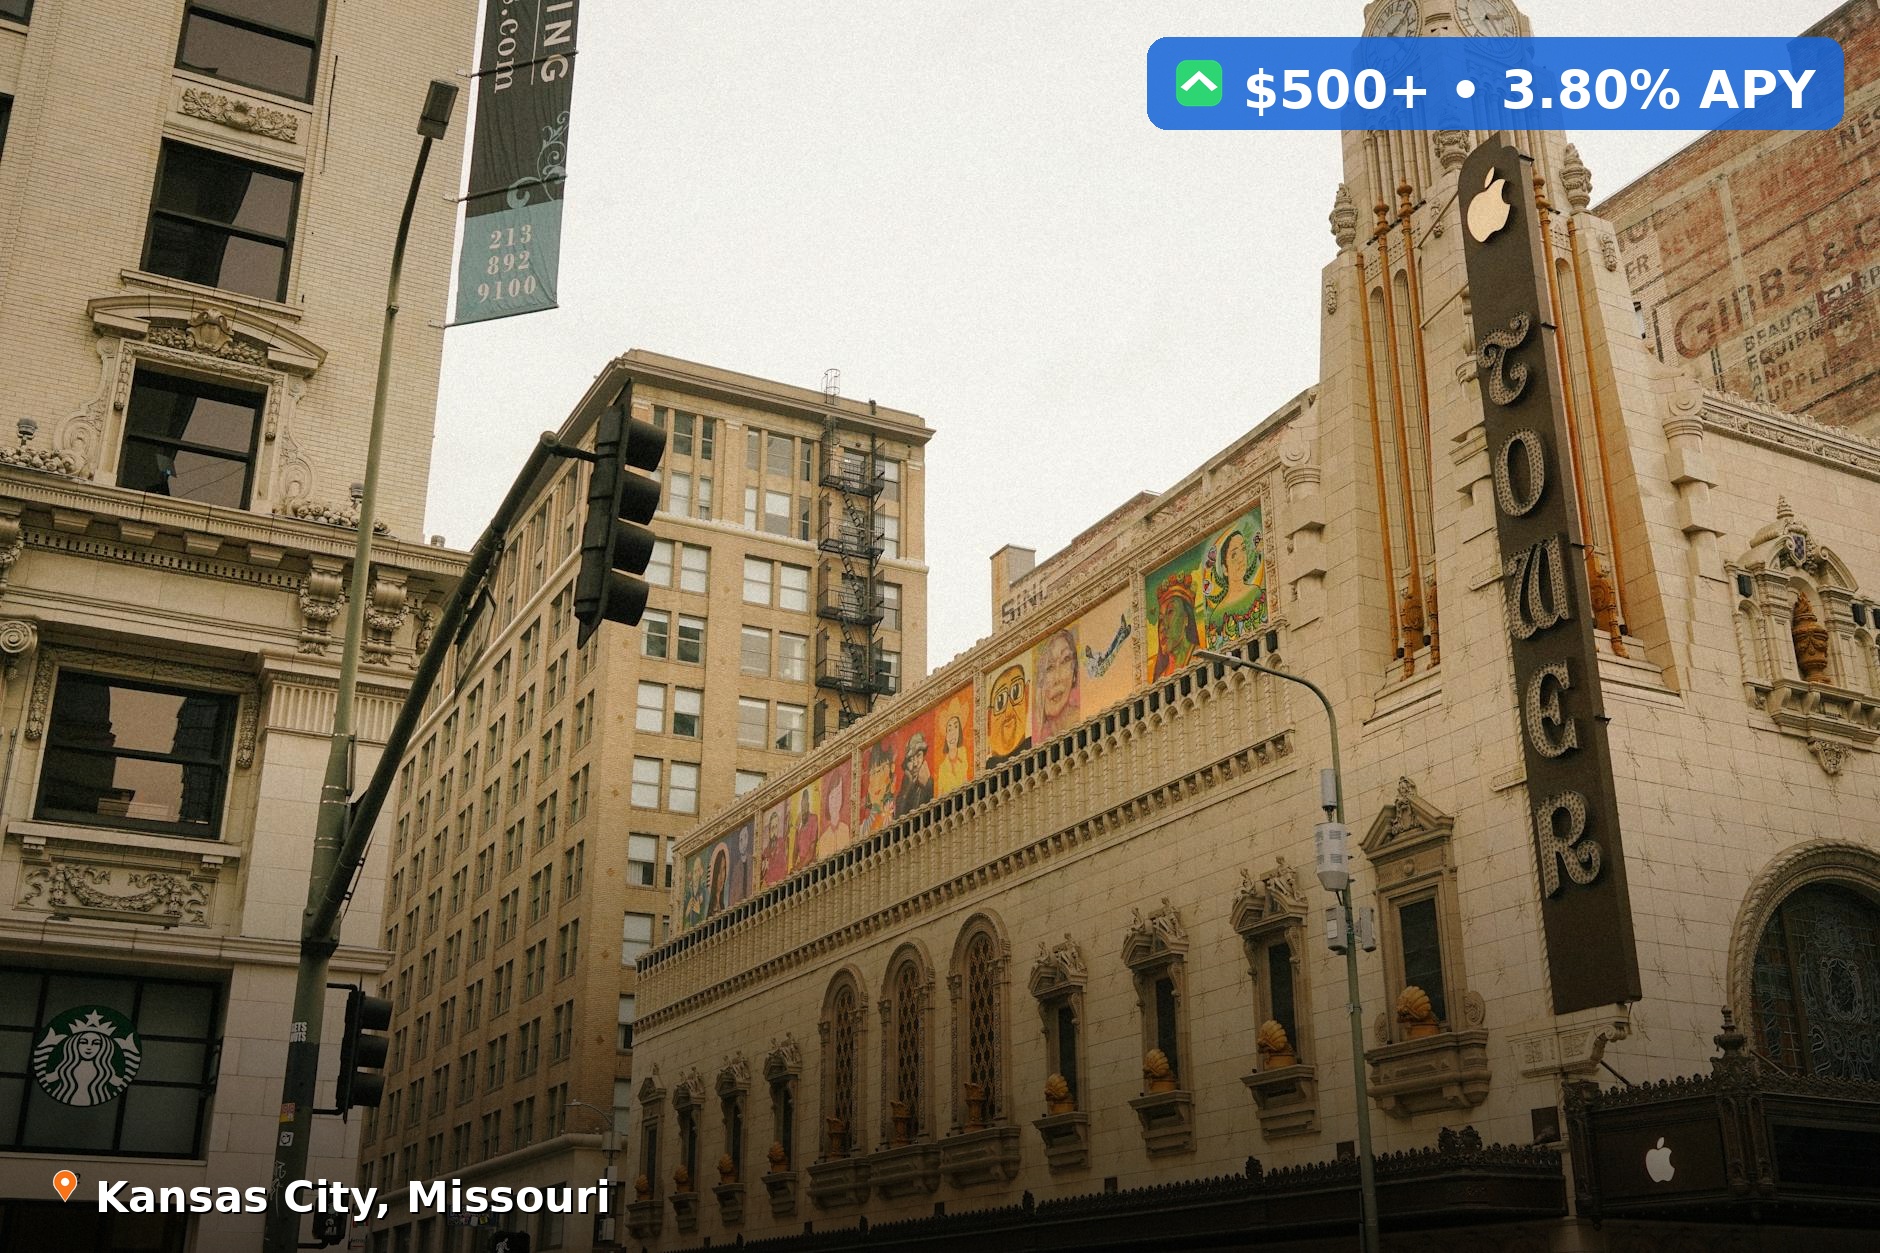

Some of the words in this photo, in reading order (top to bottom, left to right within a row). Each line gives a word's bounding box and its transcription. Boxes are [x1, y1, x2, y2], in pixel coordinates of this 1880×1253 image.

[490, 224, 533, 250] 213
[487, 250, 531, 276] 892
[477, 275, 537, 303] 9100
[1744, 301, 1814, 352] BEAUTY
[1477, 311, 1603, 899] TOWER
